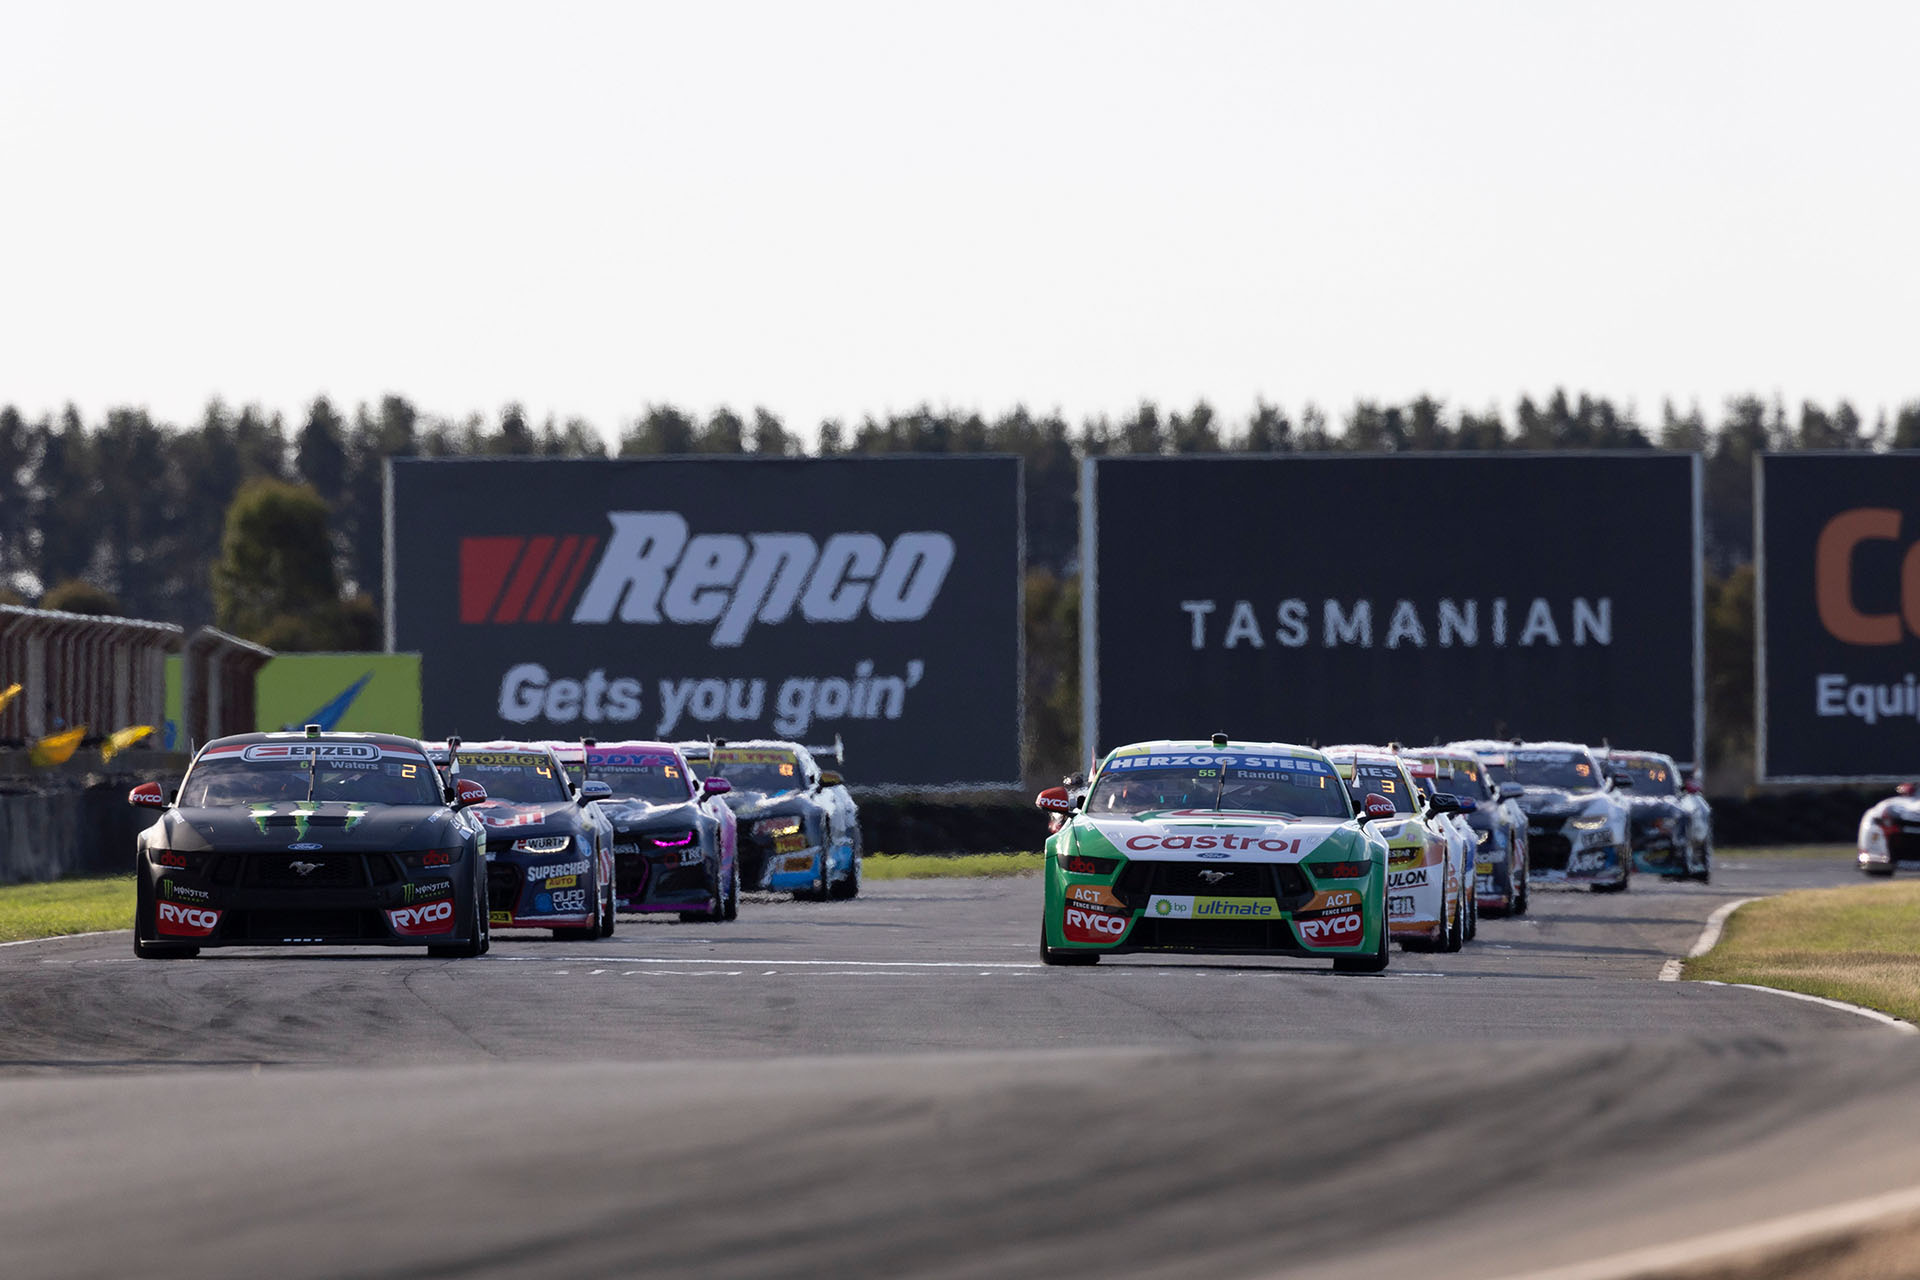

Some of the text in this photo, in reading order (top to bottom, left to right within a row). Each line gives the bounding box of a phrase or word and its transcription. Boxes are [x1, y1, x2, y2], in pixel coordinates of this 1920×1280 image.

[572, 511, 956, 648] Repco
[1815, 508, 1920, 645] C
[1181, 598, 1613, 648] TASMANIAN
[499, 658, 925, 738] Gets you goin'
[1816, 673, 1920, 725] Equi
[290, 746, 368, 756] ENZED
[330, 761, 379, 770] Waters
[458, 753, 546, 766] STORAGE
[1110, 755, 1328, 773] HERZOG STEEL
[402, 764, 417, 779] 2
[476, 764, 522, 774] Brown
[536, 766, 552, 779] 4
[1199, 769, 1217, 777] 55
[1237, 770, 1290, 781] Randle
[1381, 780, 1395, 793] 3
[132, 794, 162, 803] RYCO
[461, 789, 487, 800] RYCO
[1040, 797, 1069, 808] RYCO
[1126, 833, 1302, 854] Castrol
[549, 877, 574, 886] AUTO
[552, 889, 586, 901] QUAD
[1074, 888, 1101, 902] ACT
[1326, 893, 1353, 907] ACT
[553, 901, 586, 911] LOCK
[1073, 901, 1104, 912] FENCE HIRE
[1174, 902, 1187, 913] bp
[1197, 901, 1273, 916] ultimate
[1322, 906, 1353, 916] FENCE HIRE
[159, 903, 218, 929] RYCO
[390, 901, 452, 928] RYCO
[1066, 908, 1126, 935] RYCO
[1299, 914, 1361, 939] RYCO
